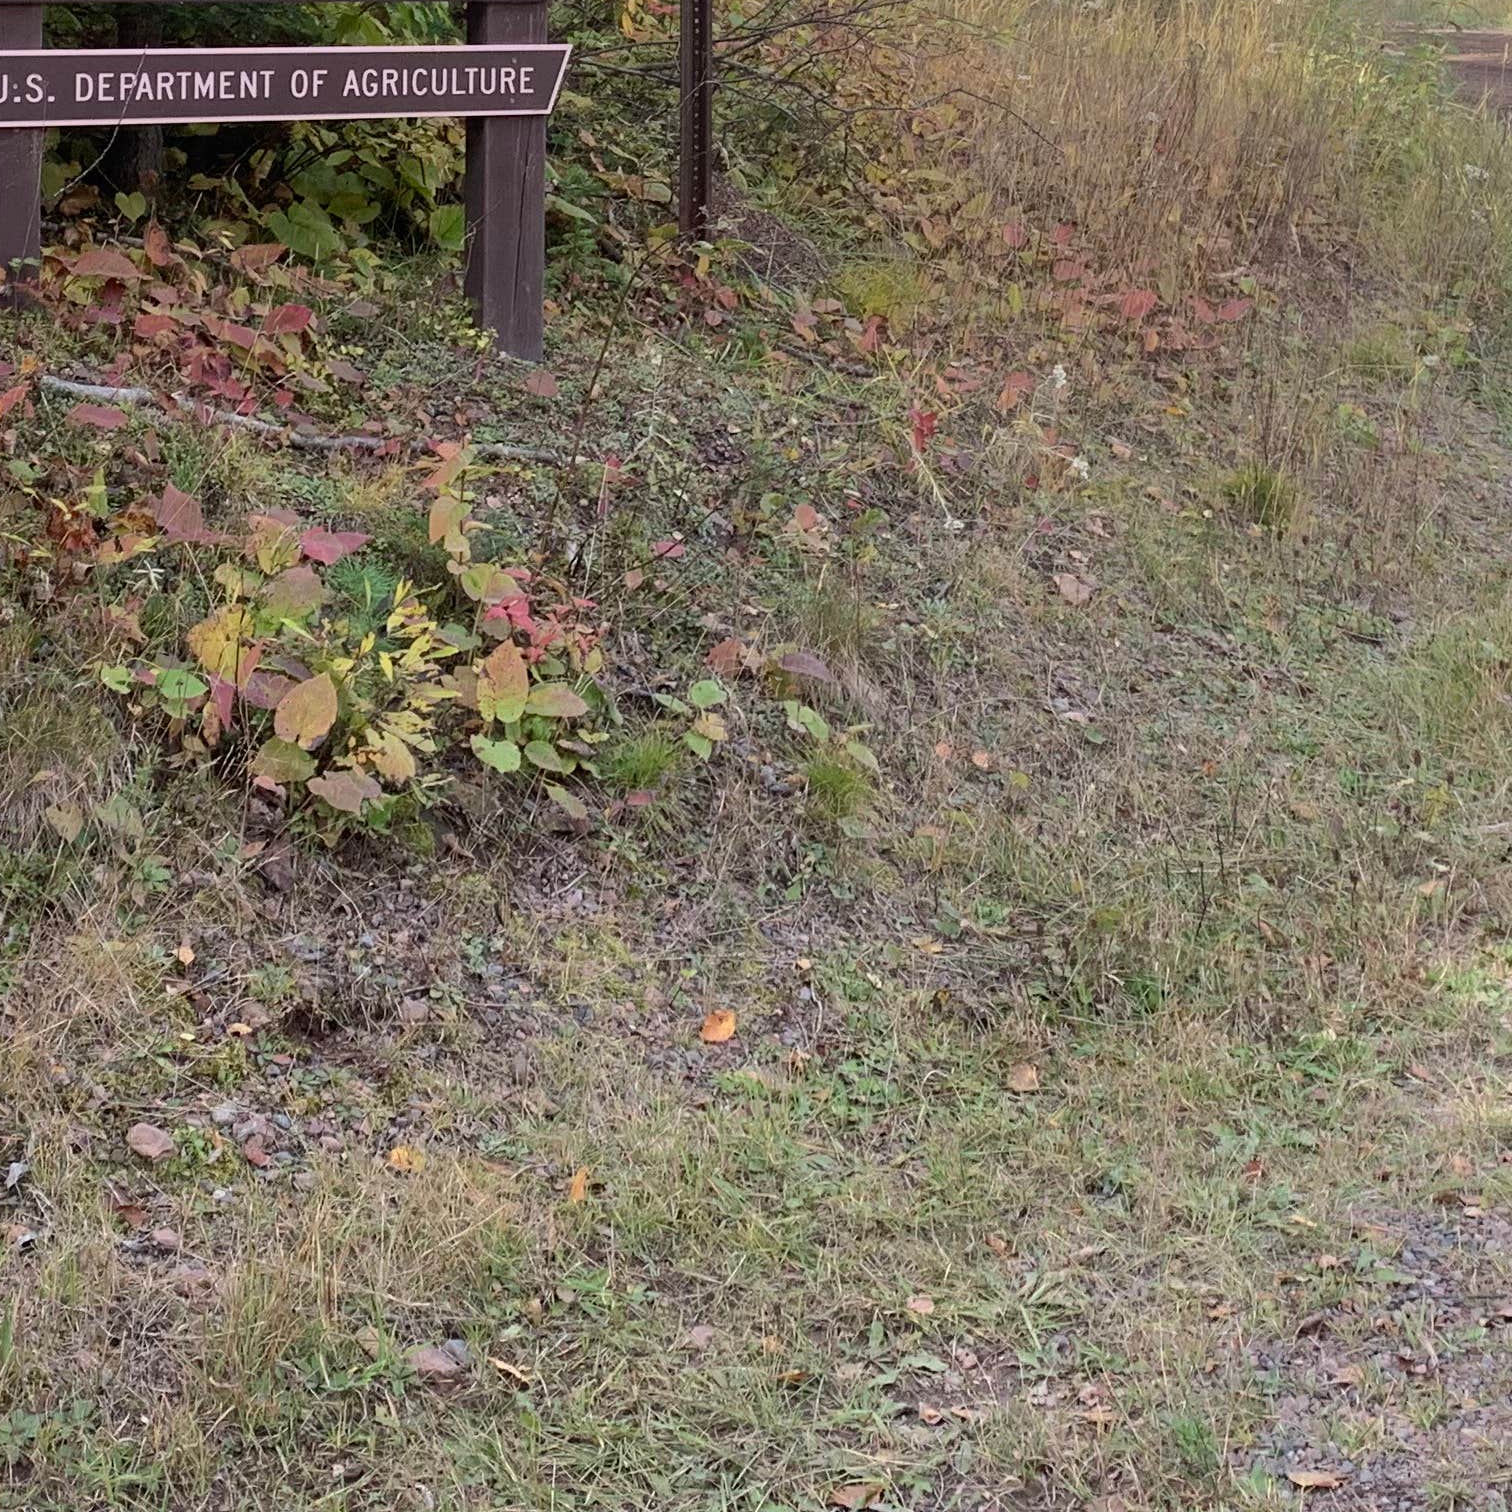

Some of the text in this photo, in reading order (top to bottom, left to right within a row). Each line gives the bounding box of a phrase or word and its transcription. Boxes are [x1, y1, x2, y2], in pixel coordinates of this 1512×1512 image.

[74, 70, 275, 103] DEPARTMENT
[290, 69, 328, 99] OF
[342, 66, 535, 97] AGRICULTURE
